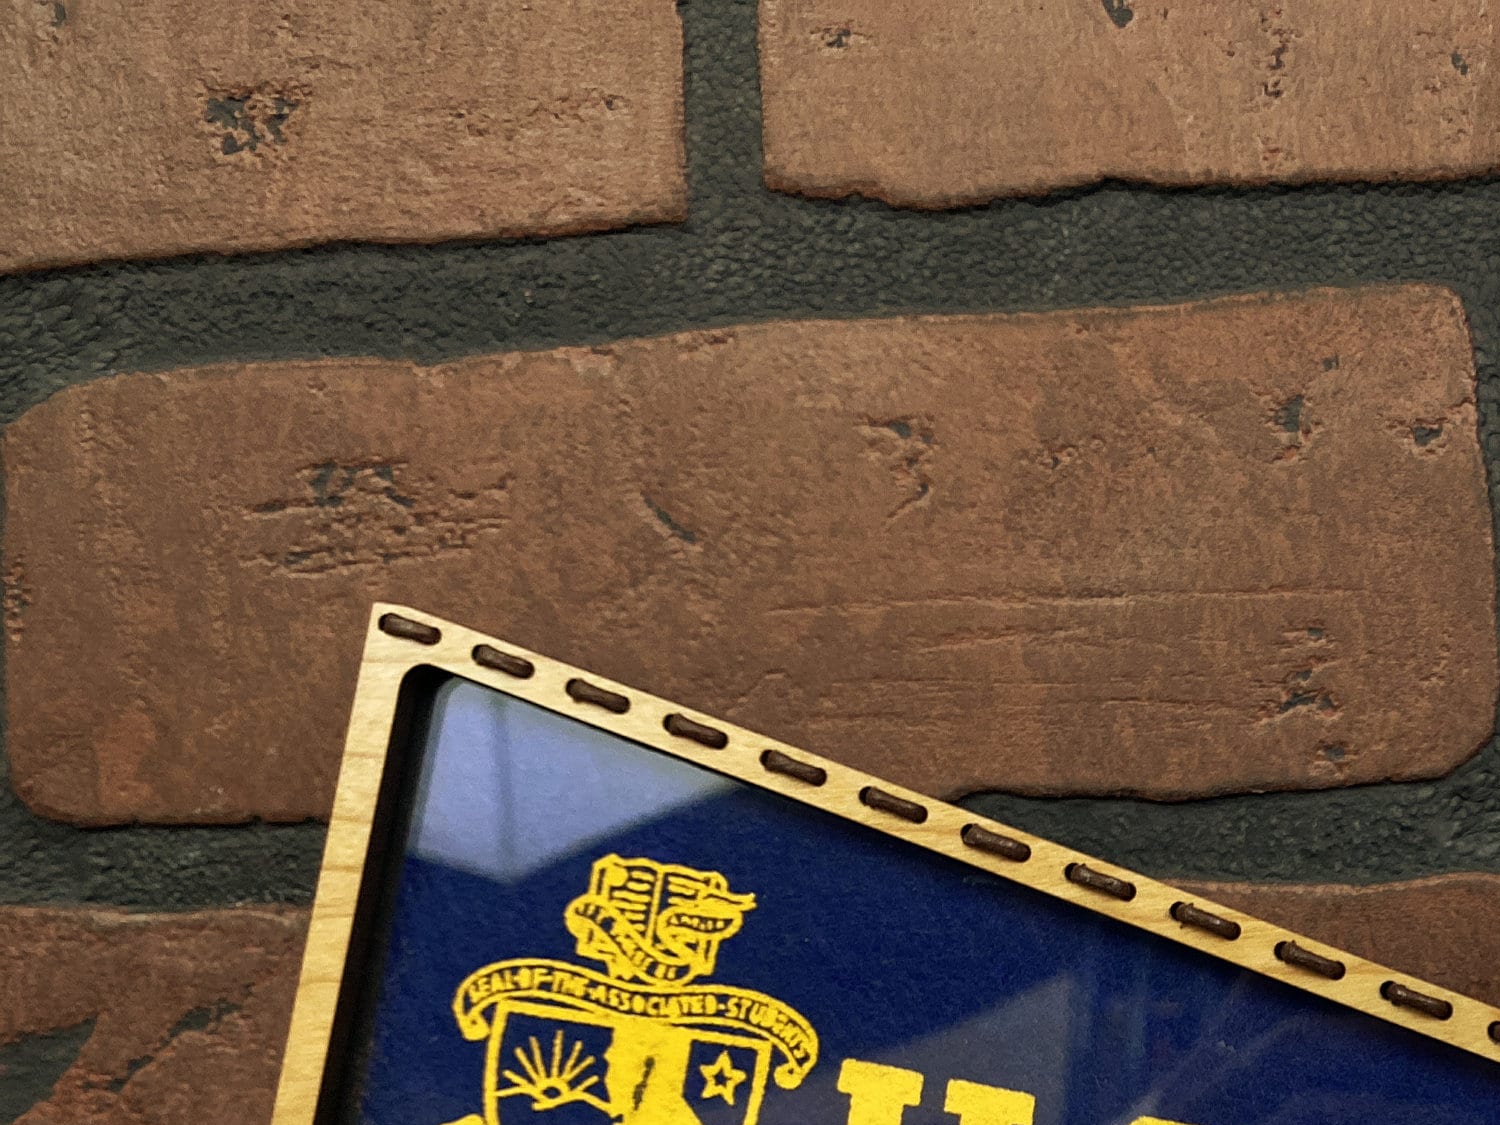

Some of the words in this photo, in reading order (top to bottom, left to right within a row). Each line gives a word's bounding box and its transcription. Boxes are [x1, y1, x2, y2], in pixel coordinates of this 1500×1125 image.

[517, 967, 548, 989] OF
[590, 984, 717, 1017] ASSOCIATED
[725, 996, 809, 1059] STUDENTS
